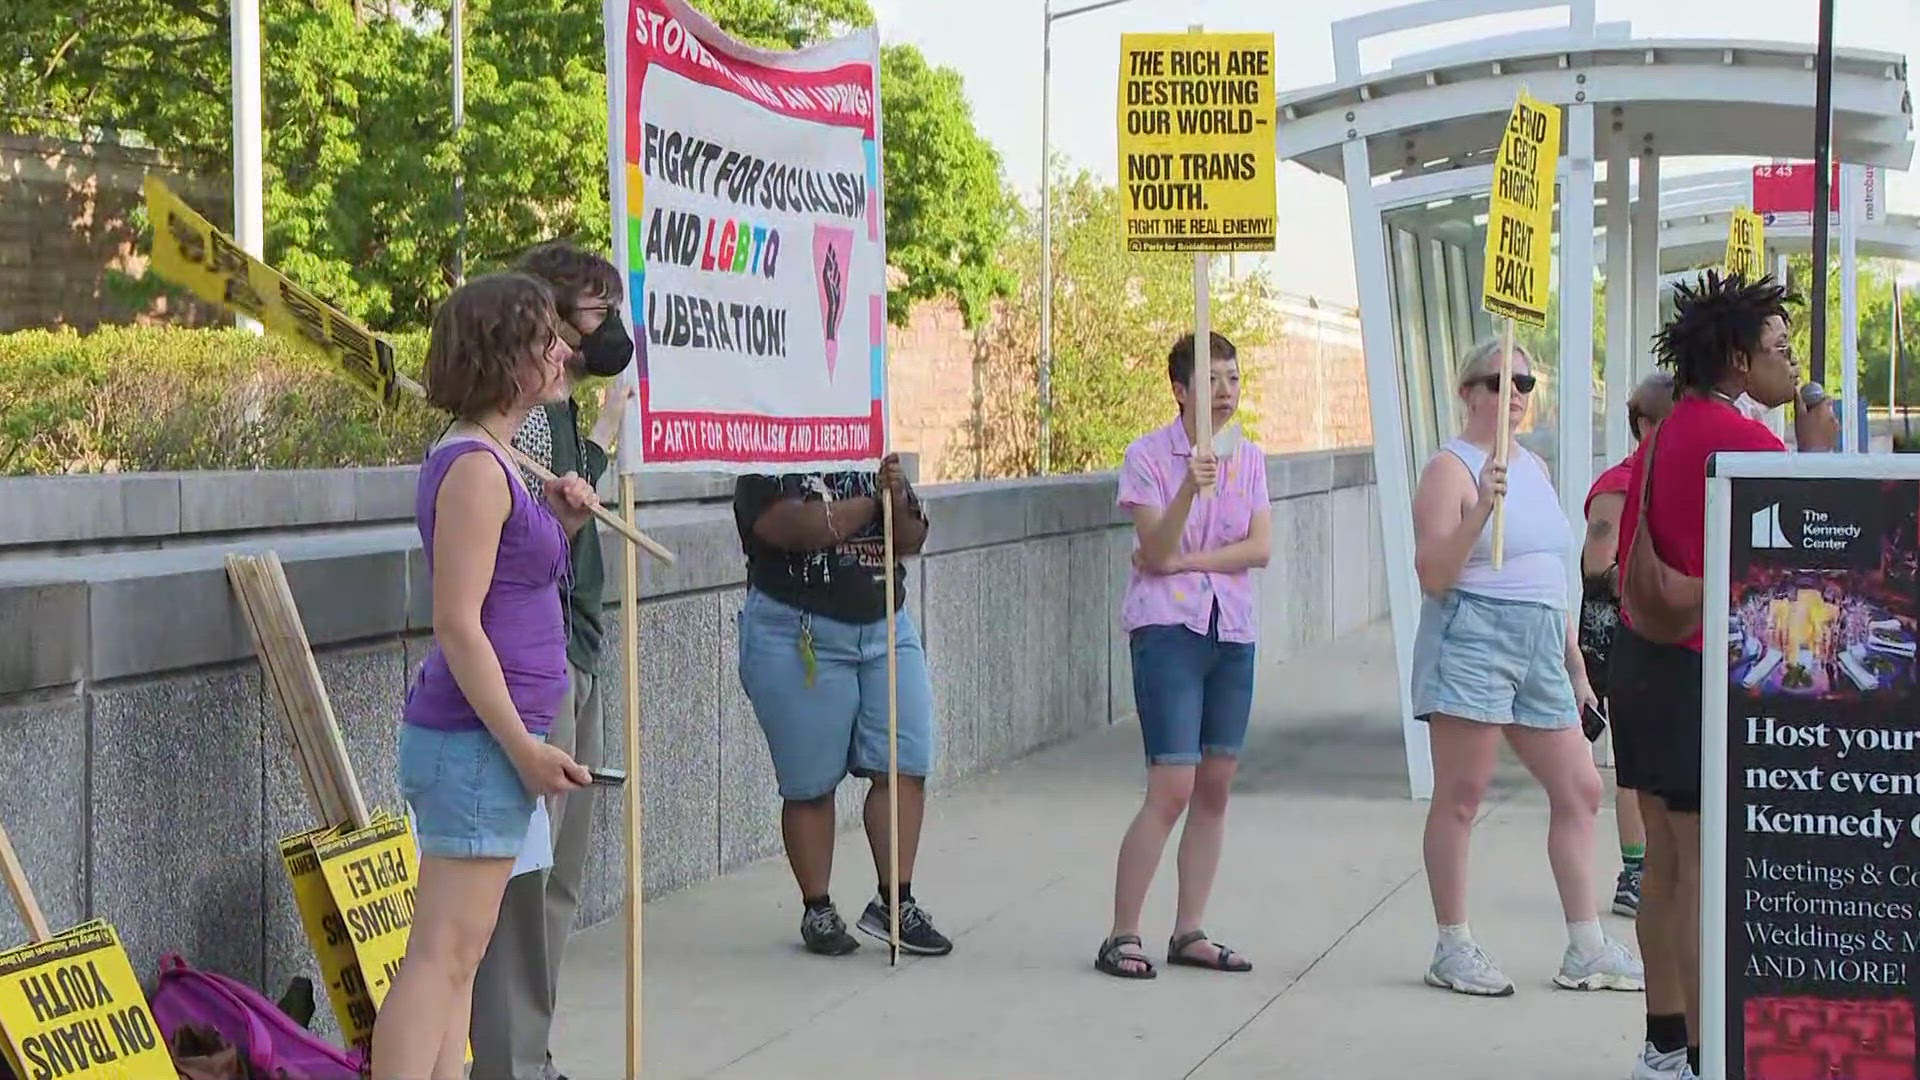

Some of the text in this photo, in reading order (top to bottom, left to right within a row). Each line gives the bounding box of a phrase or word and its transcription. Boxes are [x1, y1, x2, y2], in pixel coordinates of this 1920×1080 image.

[1130, 50, 1269, 76] THE RICH ARE
[779, 86, 817, 110] AN
[1128, 81, 1258, 105] DESTROYING
[1128, 110, 1170, 134] OUR
[644, 122, 866, 218] FIGHT FOR SOCIALISM
[1128, 153, 1256, 180] NOT TRANS
[1755, 166, 1792, 177] 42 43
[1129, 184, 1208, 210] YOUTH.
[1498, 167, 1539, 211] RIGHTS!
[1129, 218, 1272, 234] FIGHT THE REAL ENEMY!
[1500, 215, 1534, 262] FIGHT
[646, 207, 780, 279] AND LGBTQ
[1495, 255, 1534, 303] BACK!
[648, 290, 787, 358] LIBERATION!
[651, 420, 870, 453] PARTY FOR SOCIALISM AND LIBERATION
[1803, 510, 1828, 521] The
[1803, 524, 1861, 538] Kennedy
[1803, 537, 1847, 549] Center
[1745, 717, 1920, 758] Host your
[1745, 766, 1824, 791] next
[1745, 804, 1903, 848] Kennedy
[1745, 857, 1854, 890] Meetings
[1860, 863, 1882, 886] &
[346, 889, 409, 943] TRANS
[1745, 889, 1912, 920] Performances
[1744, 921, 1865, 956] Weddings
[1871, 929, 1894, 952] &
[1744, 953, 1906, 985] AND MORE!
[19, 960, 114, 1022] YOUTH
[22, 1005, 156, 1080] ON TRANS
